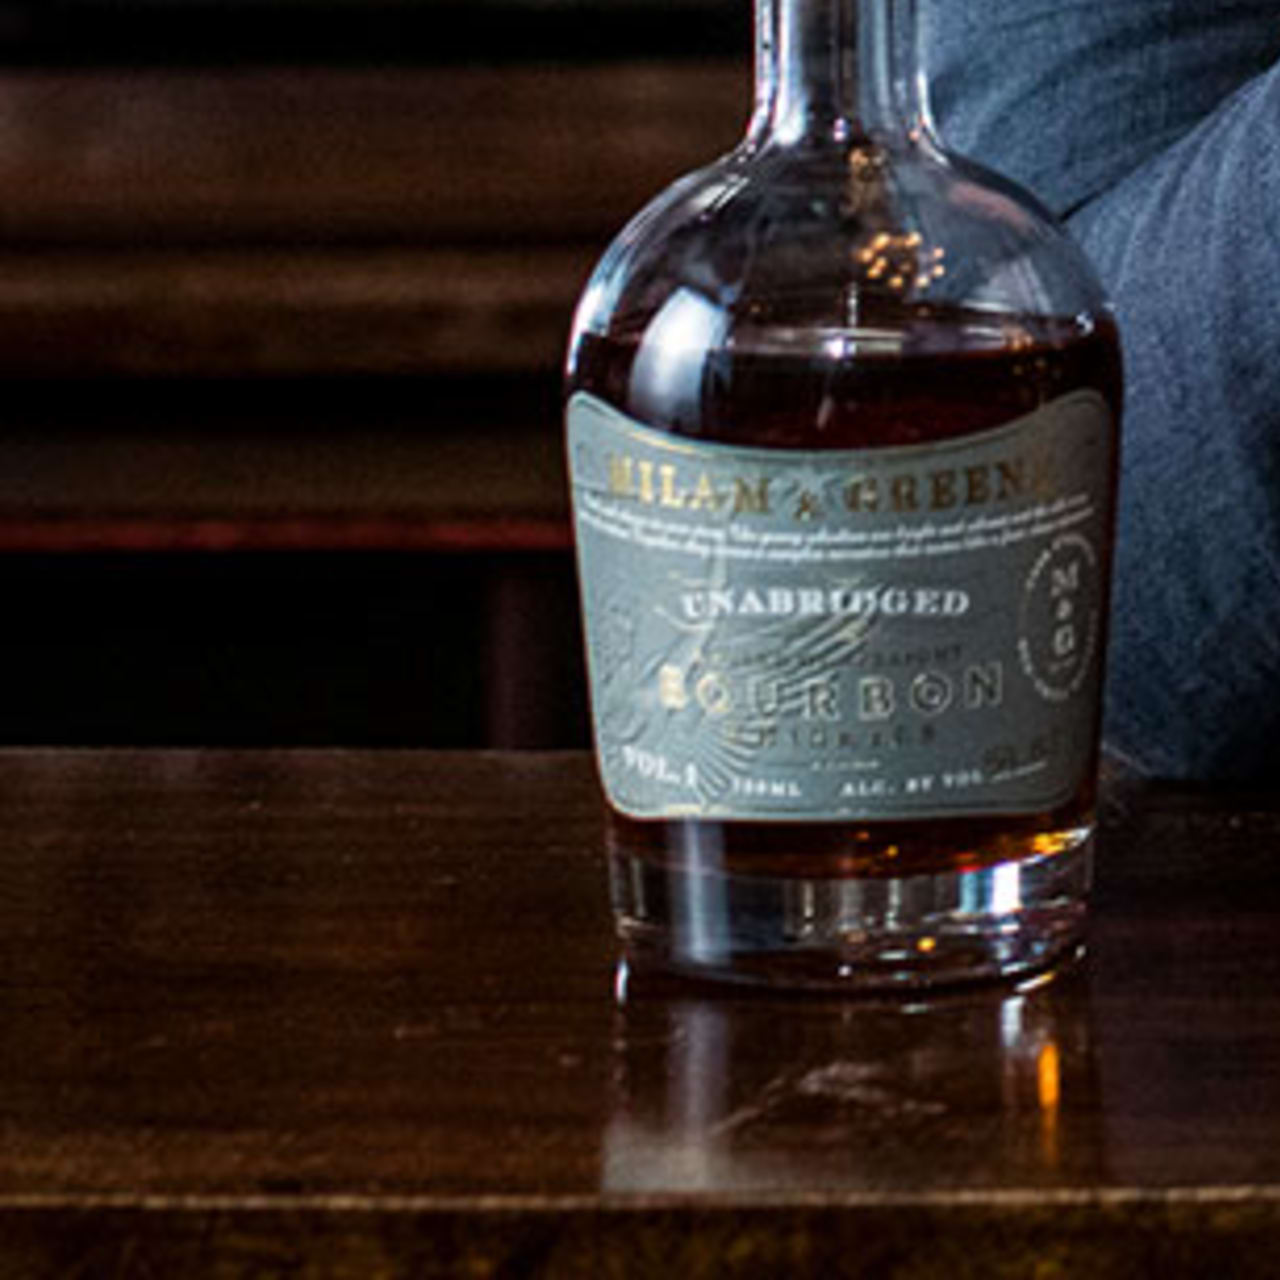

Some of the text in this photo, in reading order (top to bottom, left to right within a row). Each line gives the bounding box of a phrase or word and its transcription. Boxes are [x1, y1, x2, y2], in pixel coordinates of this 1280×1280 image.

[609, 452, 770, 513] MILAM
[683, 588, 970, 618] UNABRIDGED
[658, 663, 1003, 720] BOURBON
